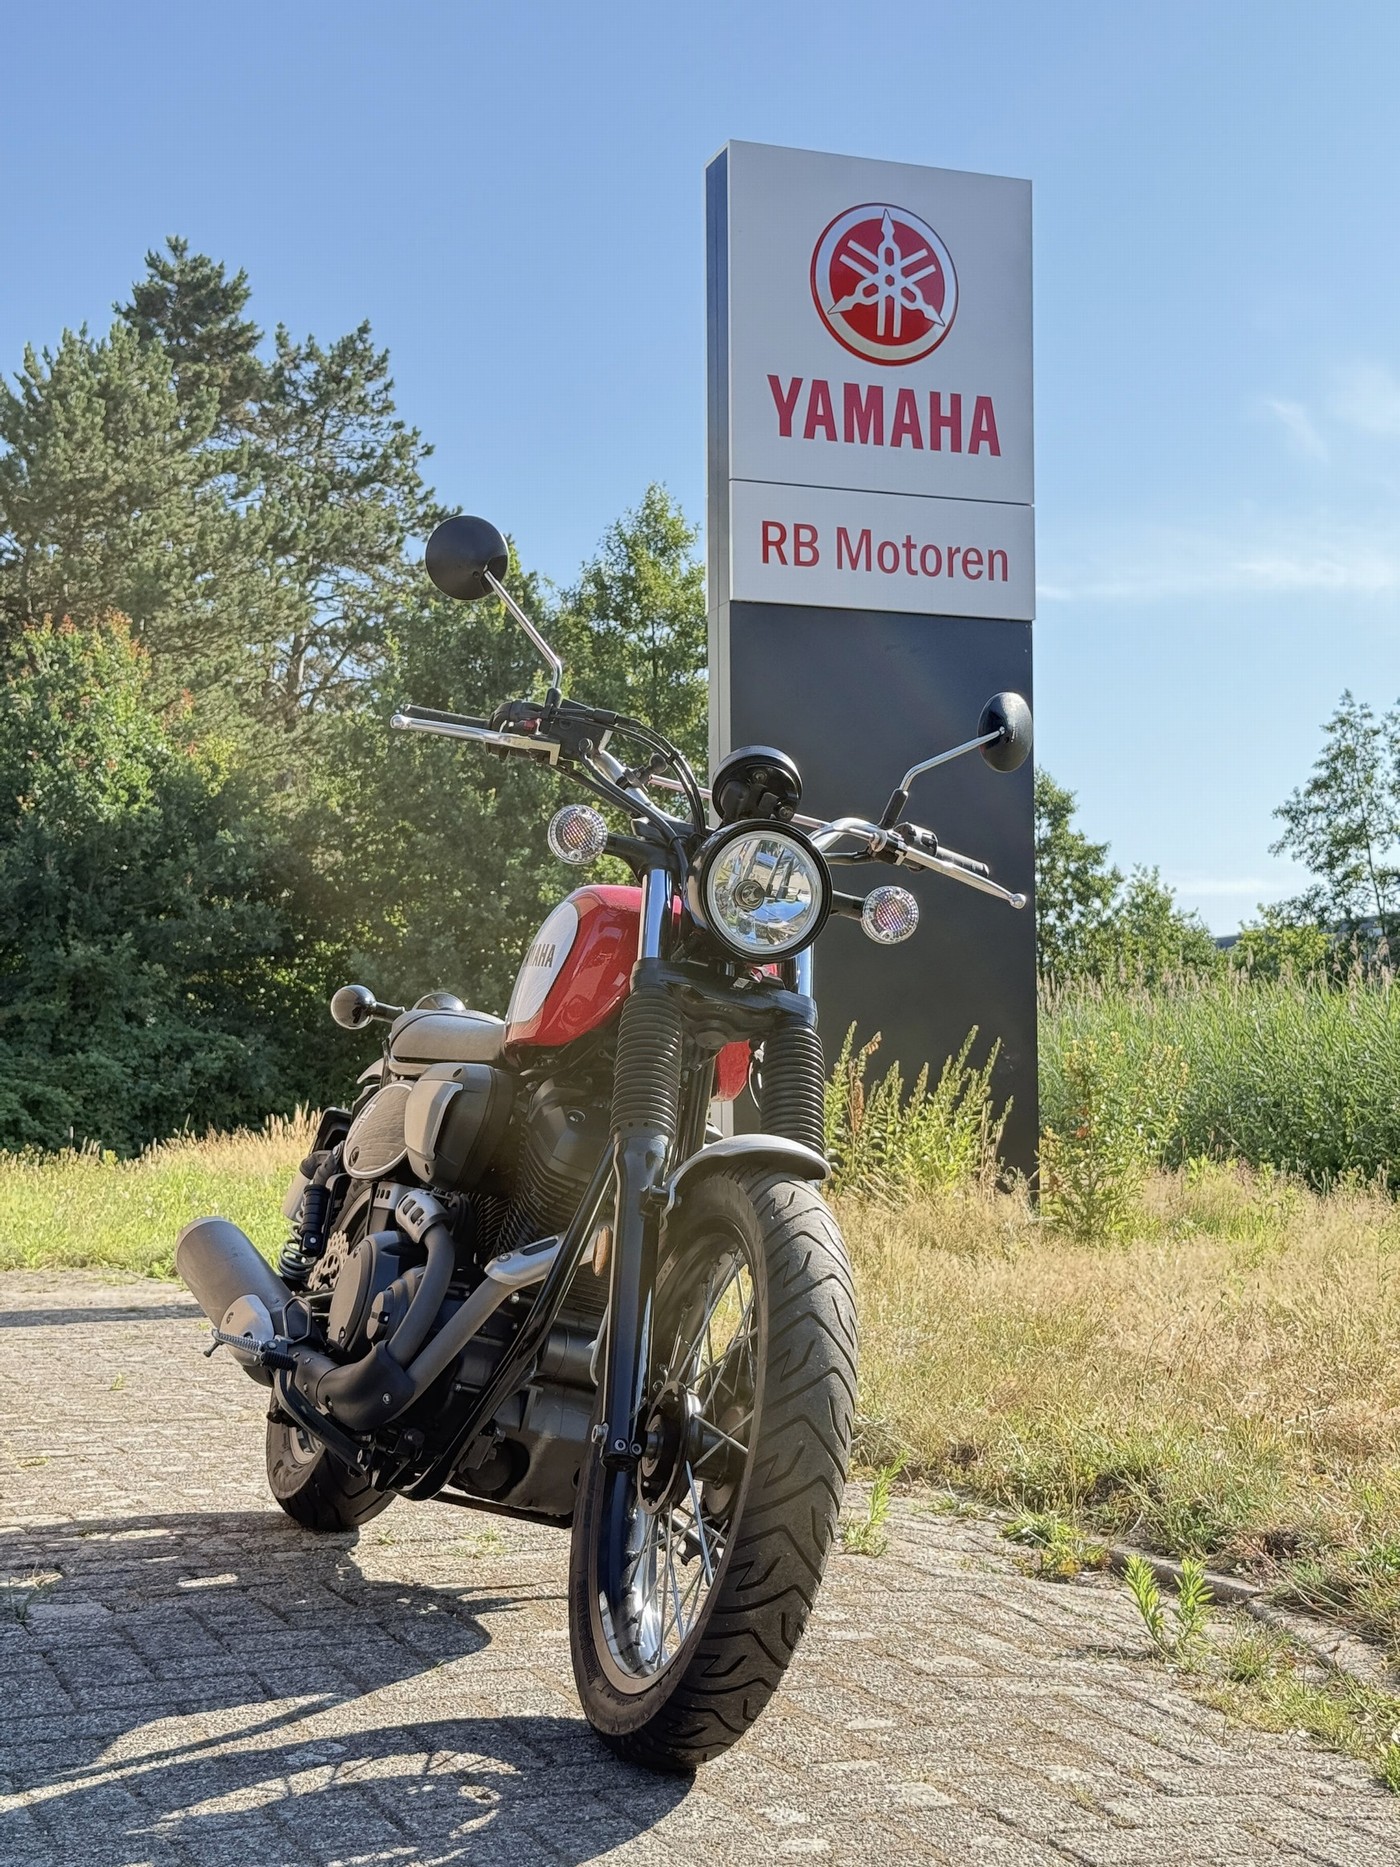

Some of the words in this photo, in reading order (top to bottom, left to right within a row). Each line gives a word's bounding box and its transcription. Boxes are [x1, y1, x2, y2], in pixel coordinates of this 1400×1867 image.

[767, 374, 1001, 457] YAMAHA
[761, 520, 820, 568] RB
[836, 527, 1009, 582] Motoren
